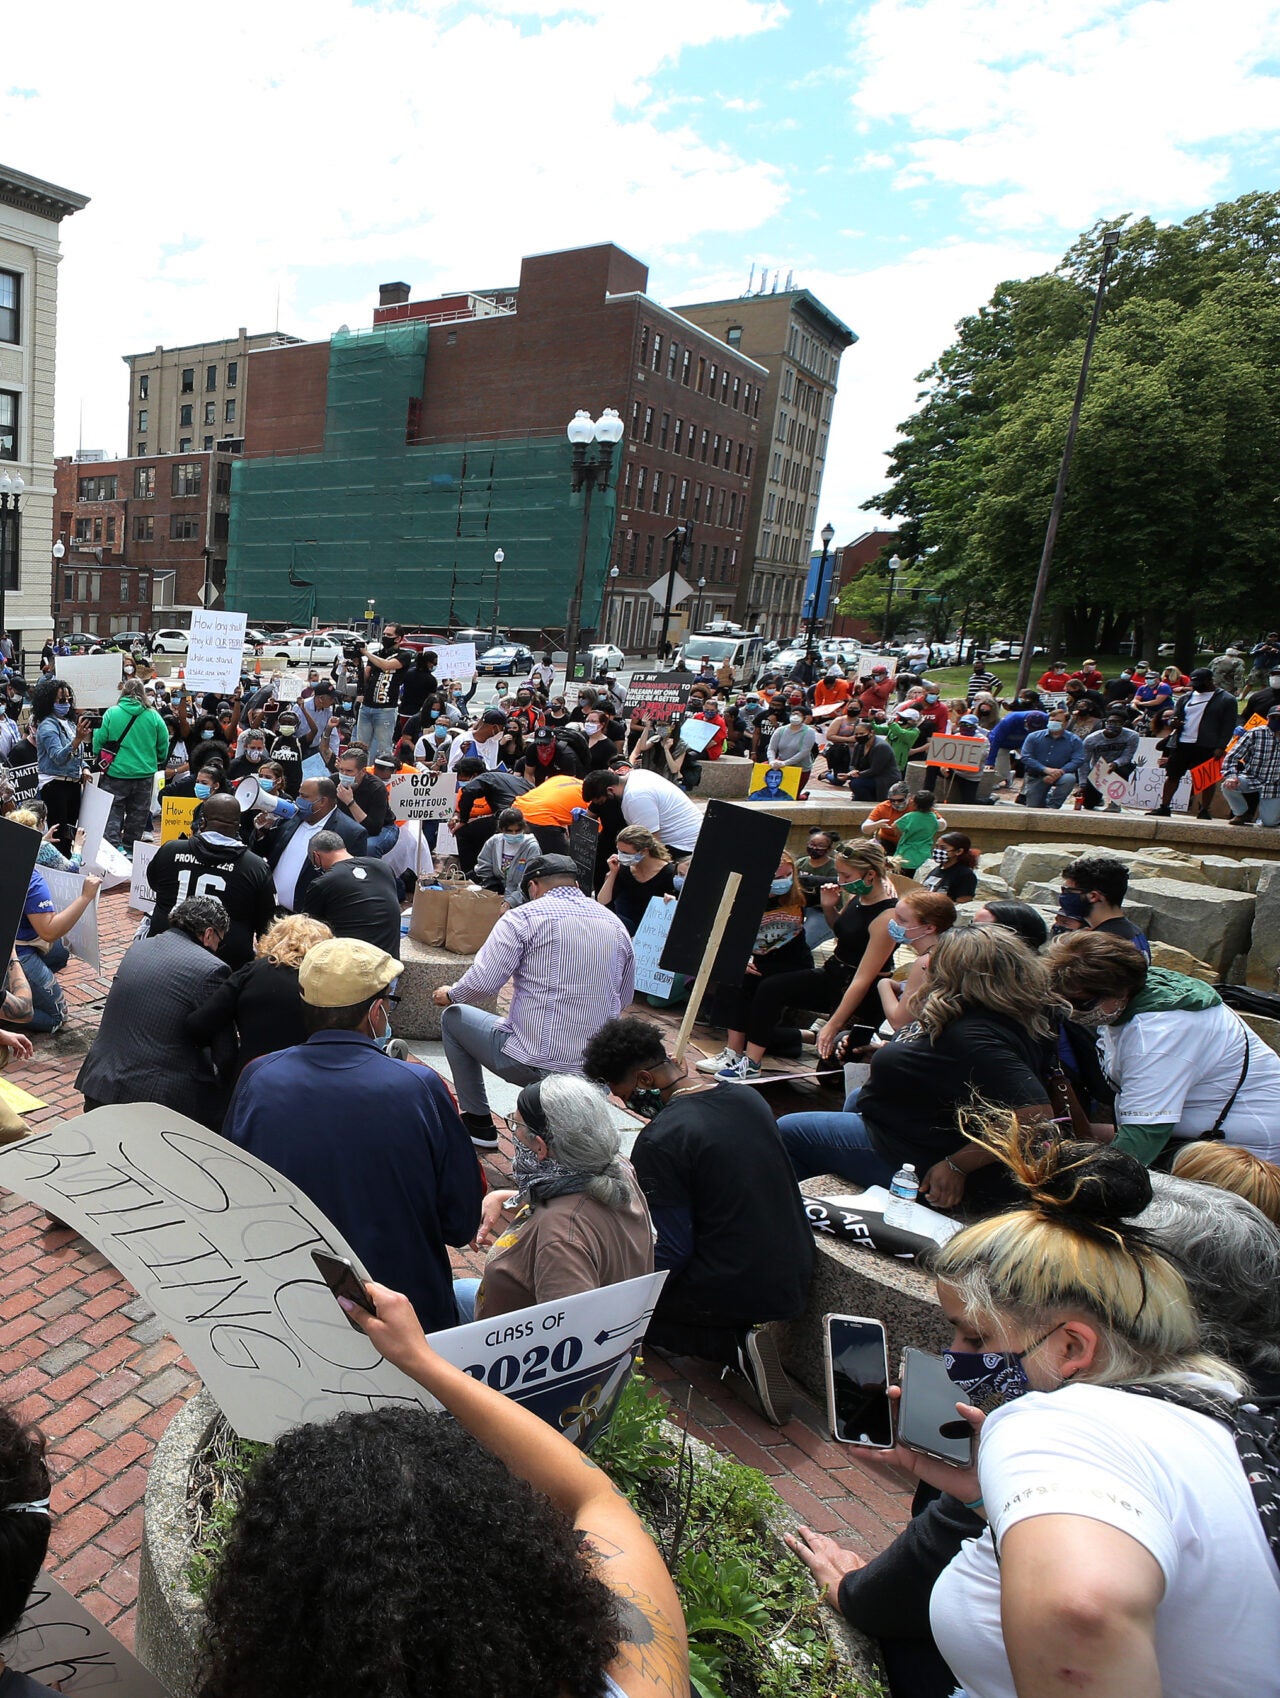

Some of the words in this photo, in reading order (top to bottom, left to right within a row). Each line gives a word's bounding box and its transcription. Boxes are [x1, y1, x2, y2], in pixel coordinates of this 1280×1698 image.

[193, 614, 213, 630] How
[931, 739, 981, 764] VOTE
[391, 775, 407, 788] BLM
[410, 774, 439, 787] GOD
[413, 787, 431, 797] OUR
[166, 801, 184, 816] How
[399, 797, 448, 808] RIGHTEOUS
[407, 809, 434, 819] JUDGE
[485, 1320, 534, 1347] CLASS
[541, 1311, 566, 1332] OF
[461, 1336, 584, 1392] 2020
